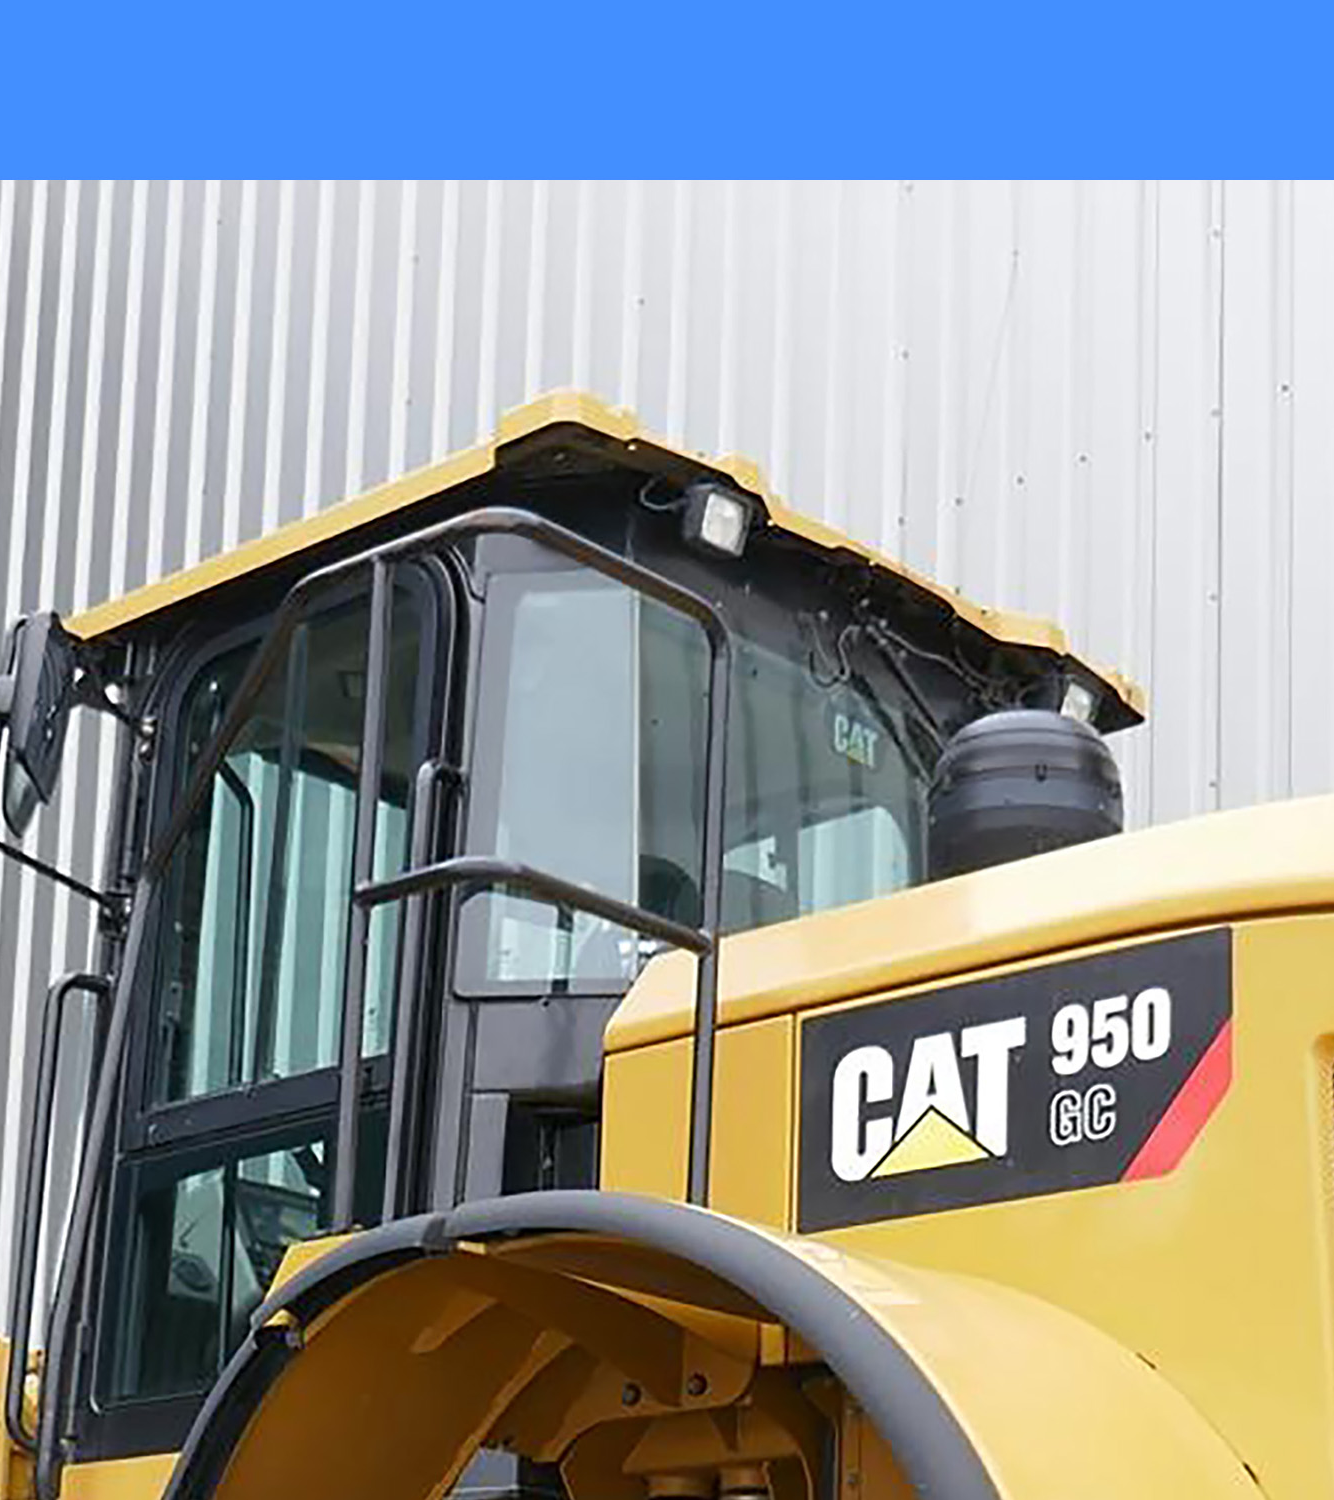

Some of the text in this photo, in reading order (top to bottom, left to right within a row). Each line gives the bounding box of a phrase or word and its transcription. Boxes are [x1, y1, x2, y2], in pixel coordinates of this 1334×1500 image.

[833, 712, 880, 768] CAT
[830, 986, 1171, 1182] CAT 950
[1049, 1083, 1116, 1146] GC
